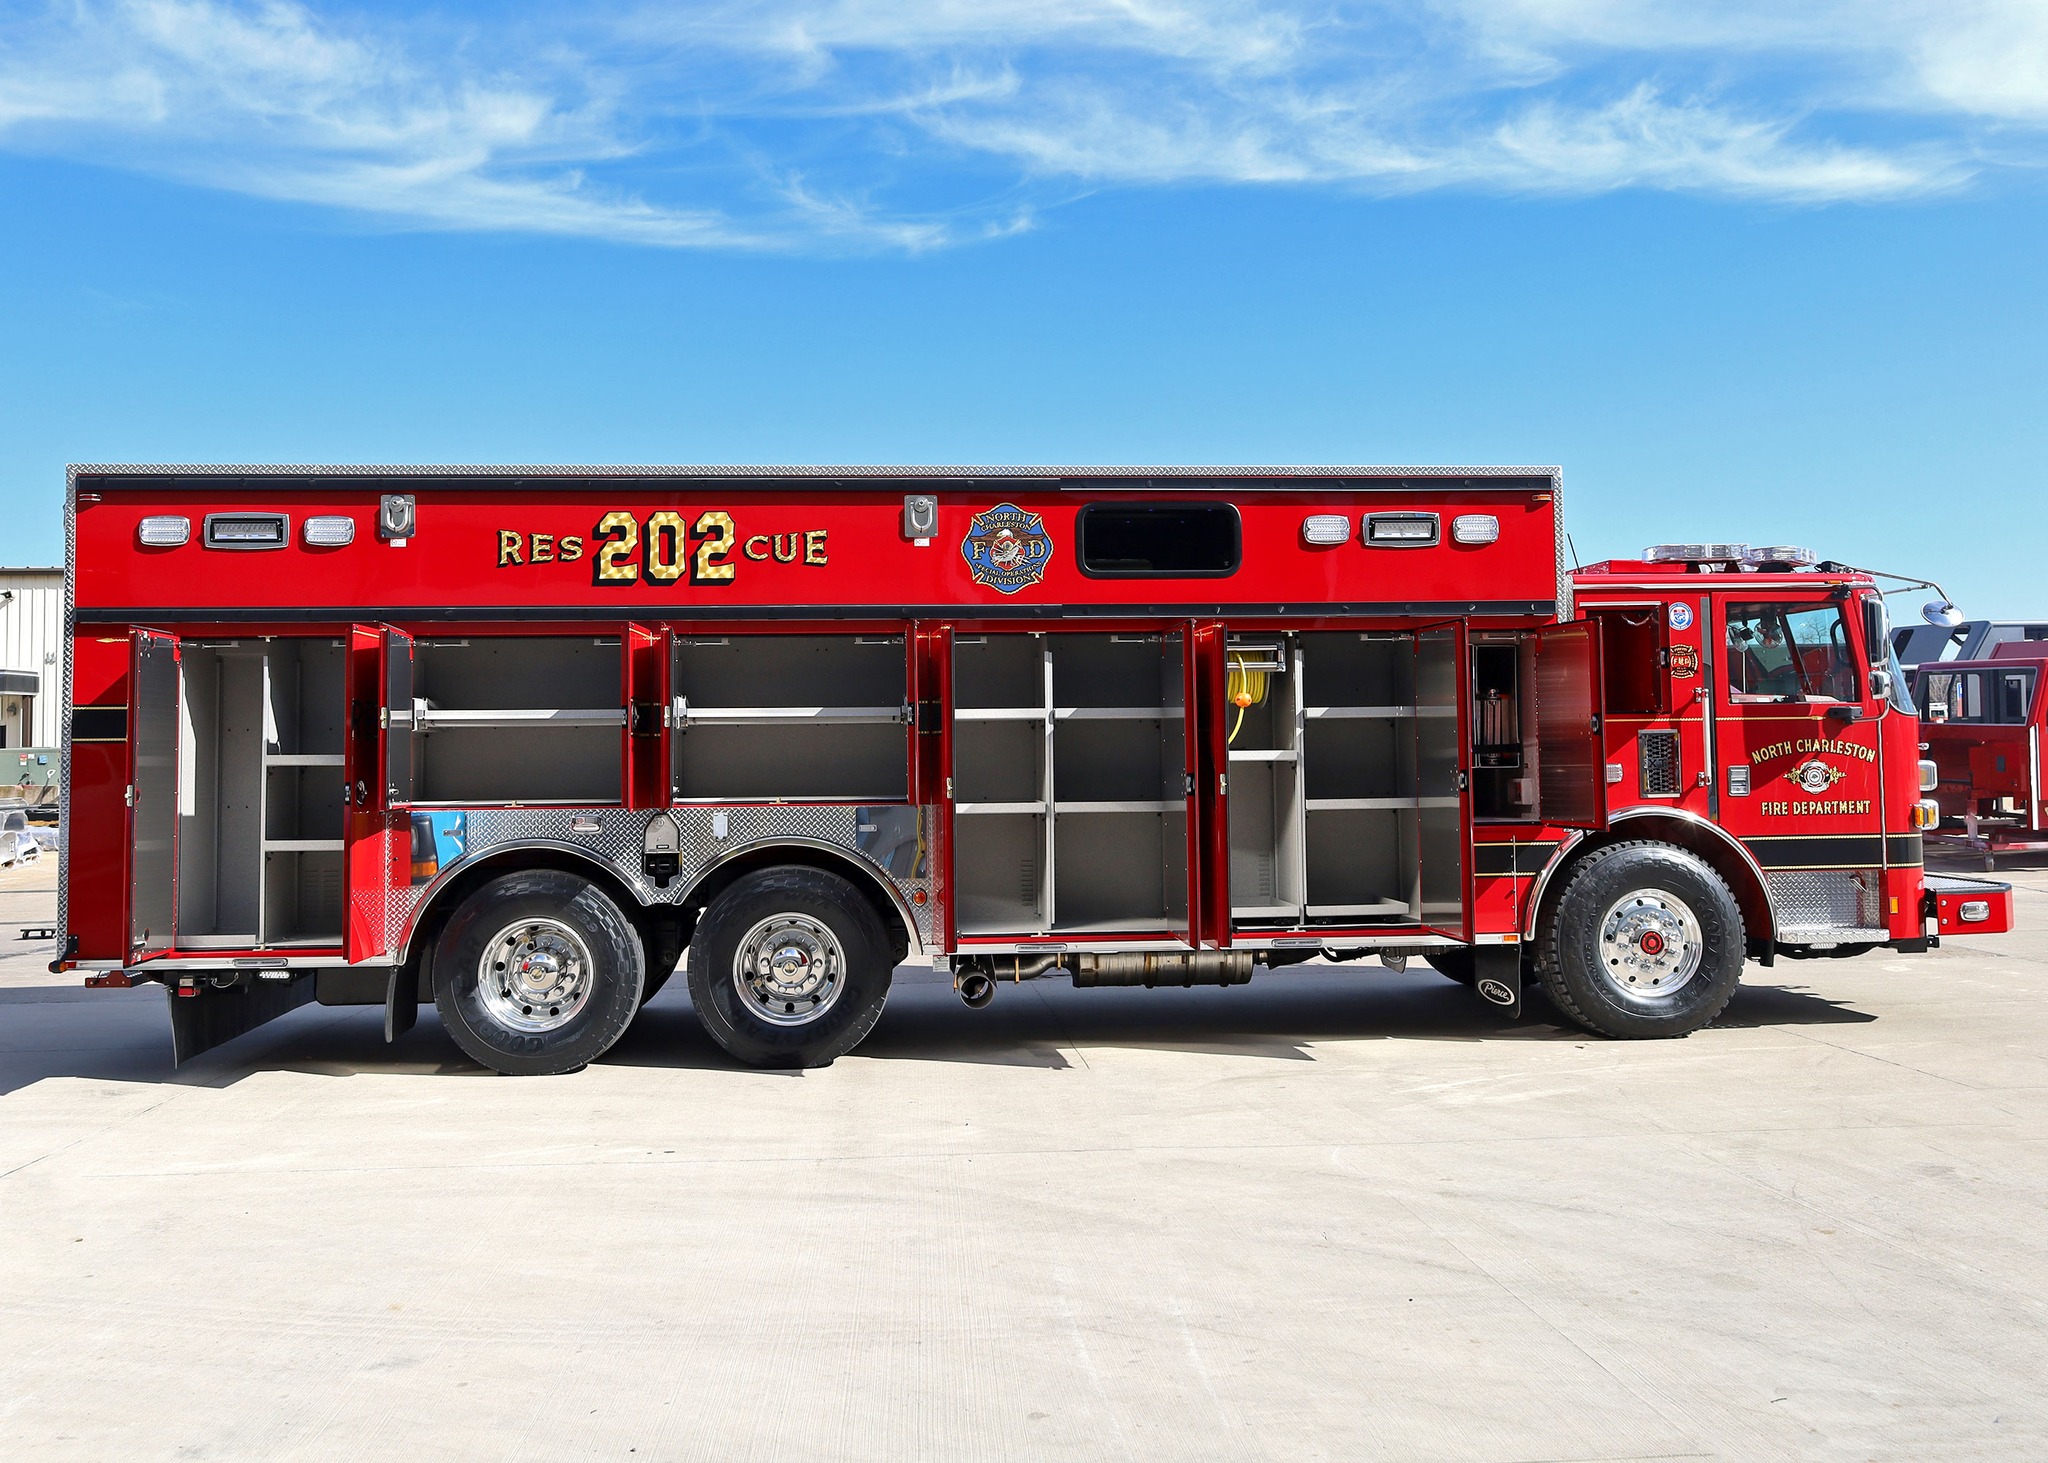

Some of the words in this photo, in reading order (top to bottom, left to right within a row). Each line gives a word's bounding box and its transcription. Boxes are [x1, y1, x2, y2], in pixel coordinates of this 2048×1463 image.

[985, 512, 1027, 523] NORTH
[981, 521, 1031, 531] CHARLESTON
[497, 529, 583, 567] RES
[592, 511, 736, 586] 202
[742, 529, 829, 567] CUE
[972, 541, 986, 560] F
[1028, 540, 1045, 558] D
[975, 563, 999, 577] SPECIAL
[1001, 561, 1042, 577] OPERATIONS
[985, 575, 1032, 585] DIVISION
[1751, 741, 1792, 764] NORTH
[1796, 739, 1876, 763] CHARLESTON
[1761, 802, 1788, 816] FIRE
[1793, 800, 1871, 815] DEPARTMENT
[1484, 982, 1510, 1001] Pierce
